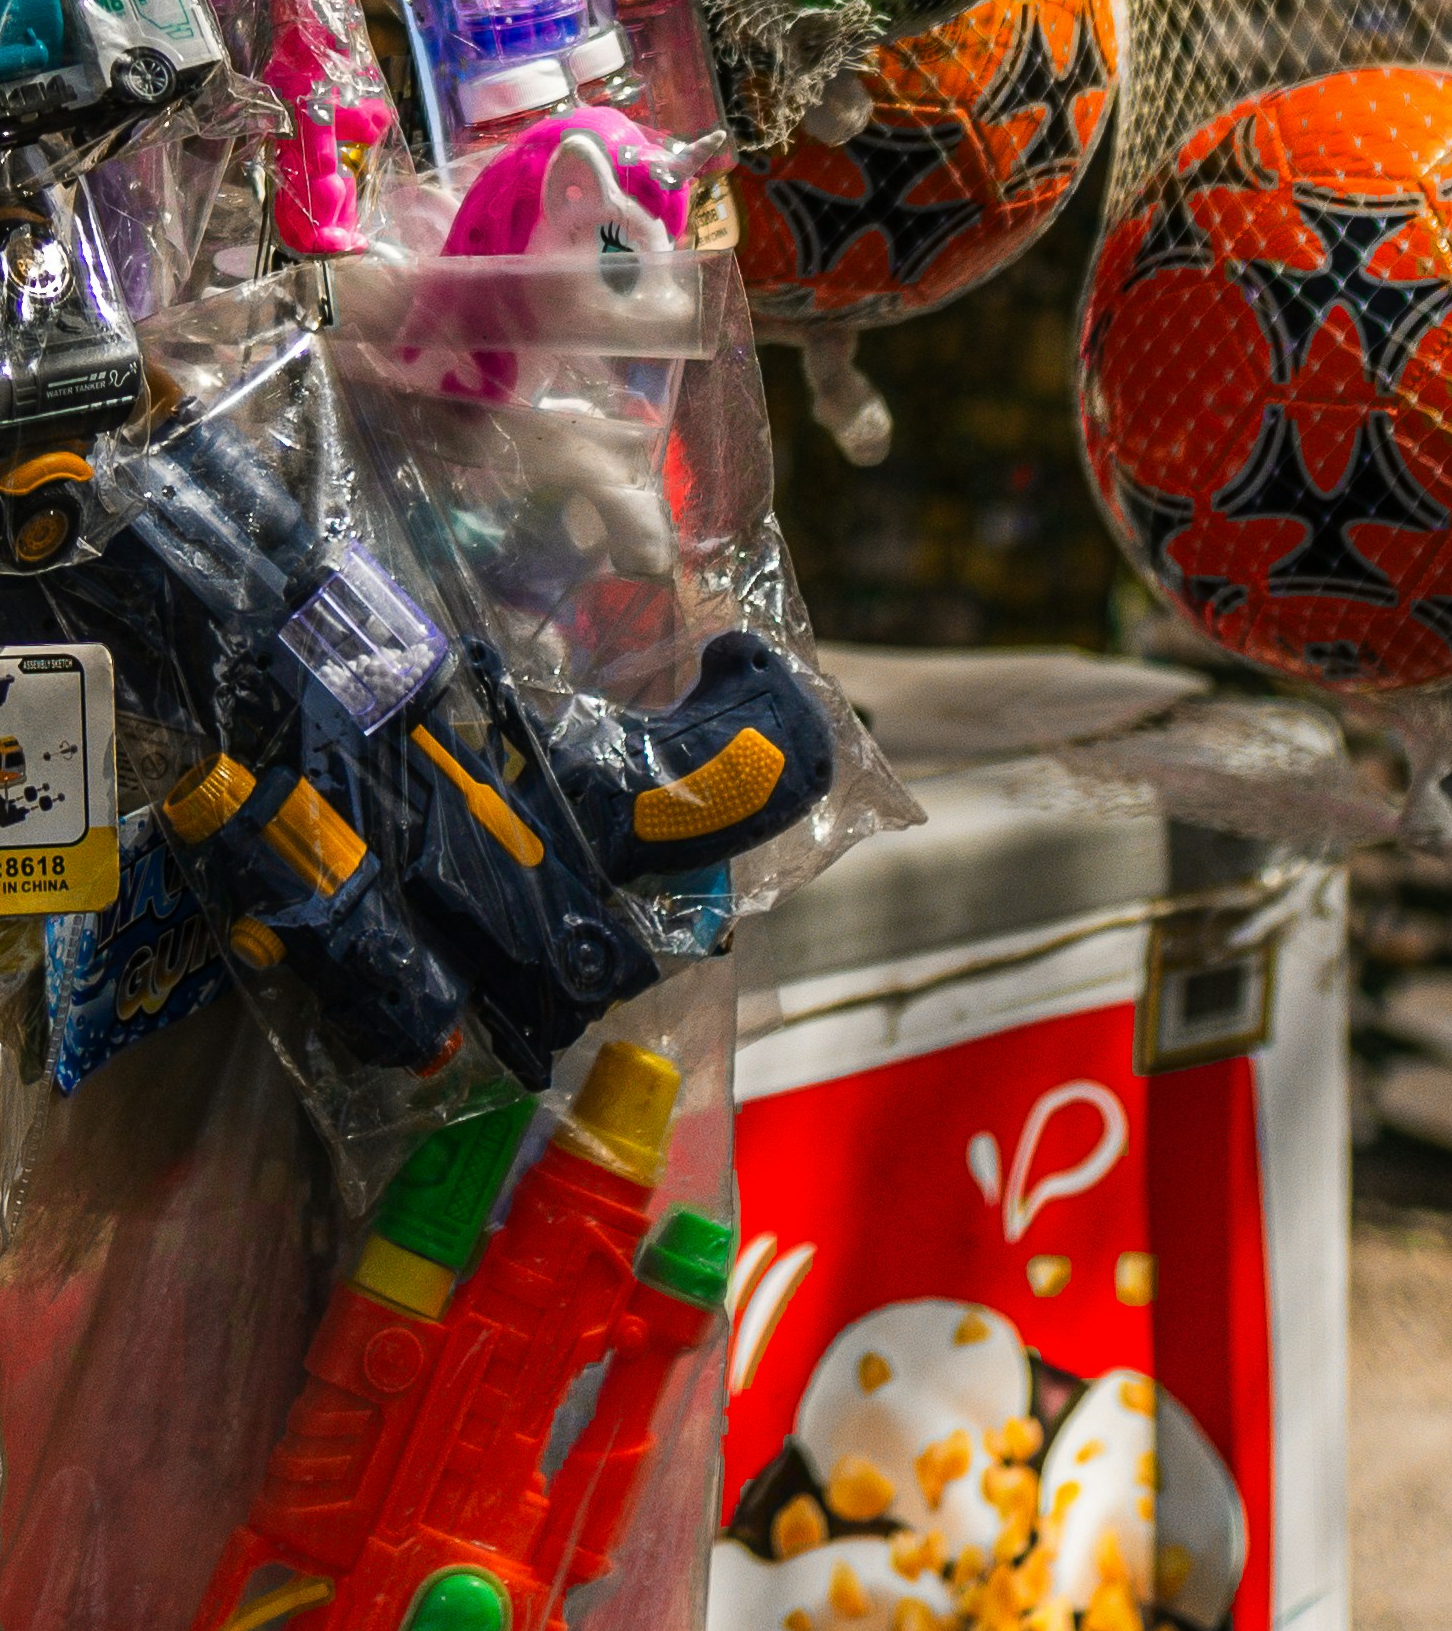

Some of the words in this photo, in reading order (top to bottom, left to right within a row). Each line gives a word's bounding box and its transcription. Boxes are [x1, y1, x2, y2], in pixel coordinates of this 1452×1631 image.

[45, 386, 74, 399] WATER
[75, 380, 107, 394] TANKER
[50, 658, 74, 669] SKETCH
[2, 881, 19, 895] IN
[22, 878, 70, 893] CHINA
